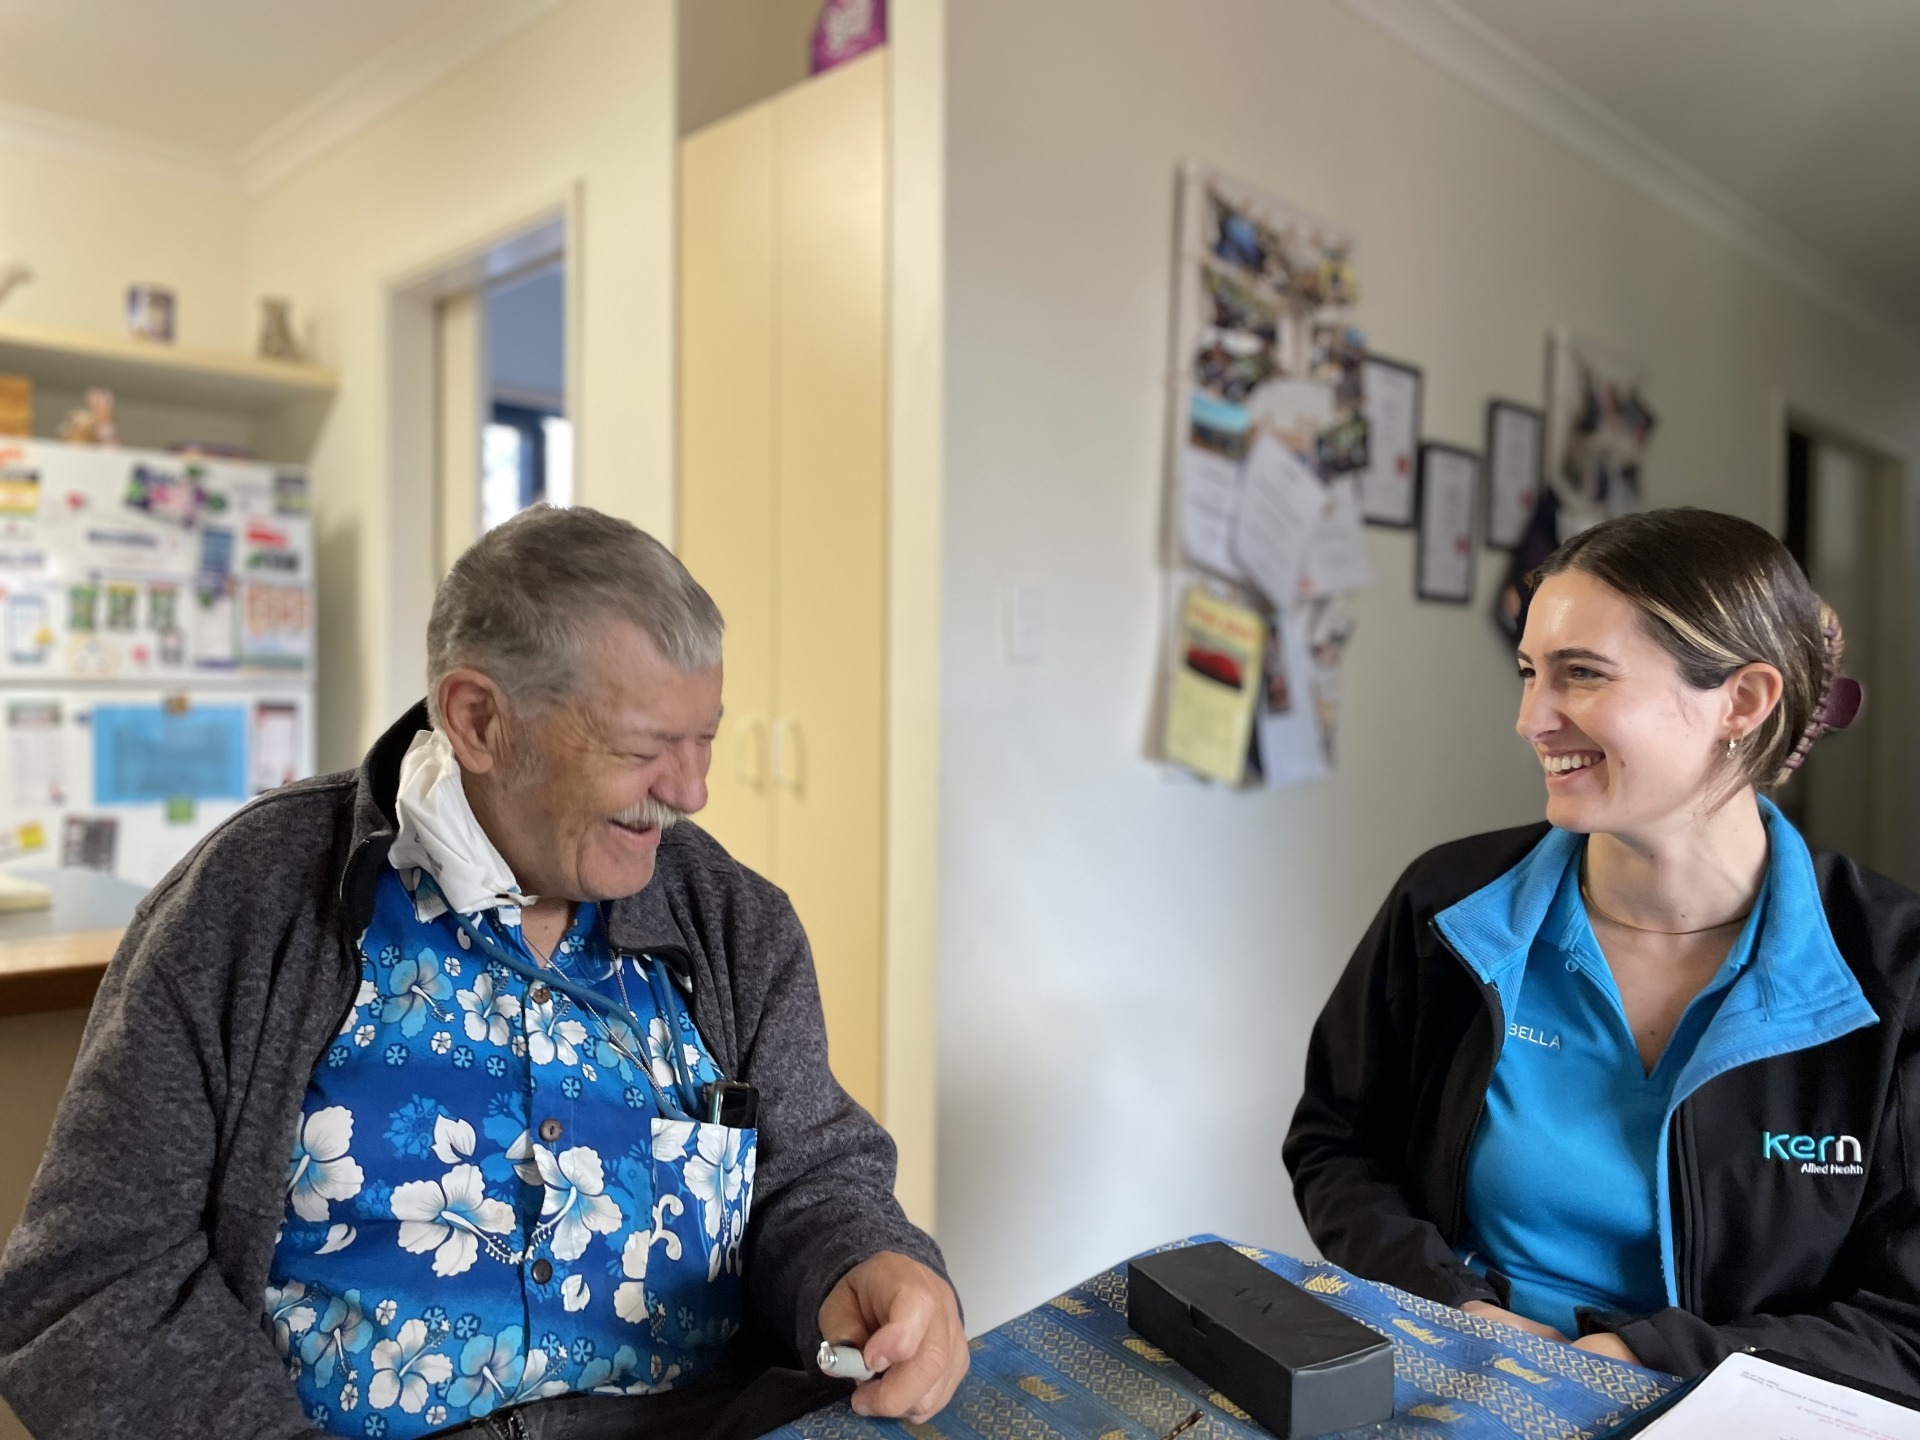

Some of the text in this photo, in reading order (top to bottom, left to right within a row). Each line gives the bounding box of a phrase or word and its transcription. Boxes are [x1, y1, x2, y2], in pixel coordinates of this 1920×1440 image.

[1508, 1022, 1561, 1050] BELLA
[1801, 1162, 1864, 1175] Allied Health
